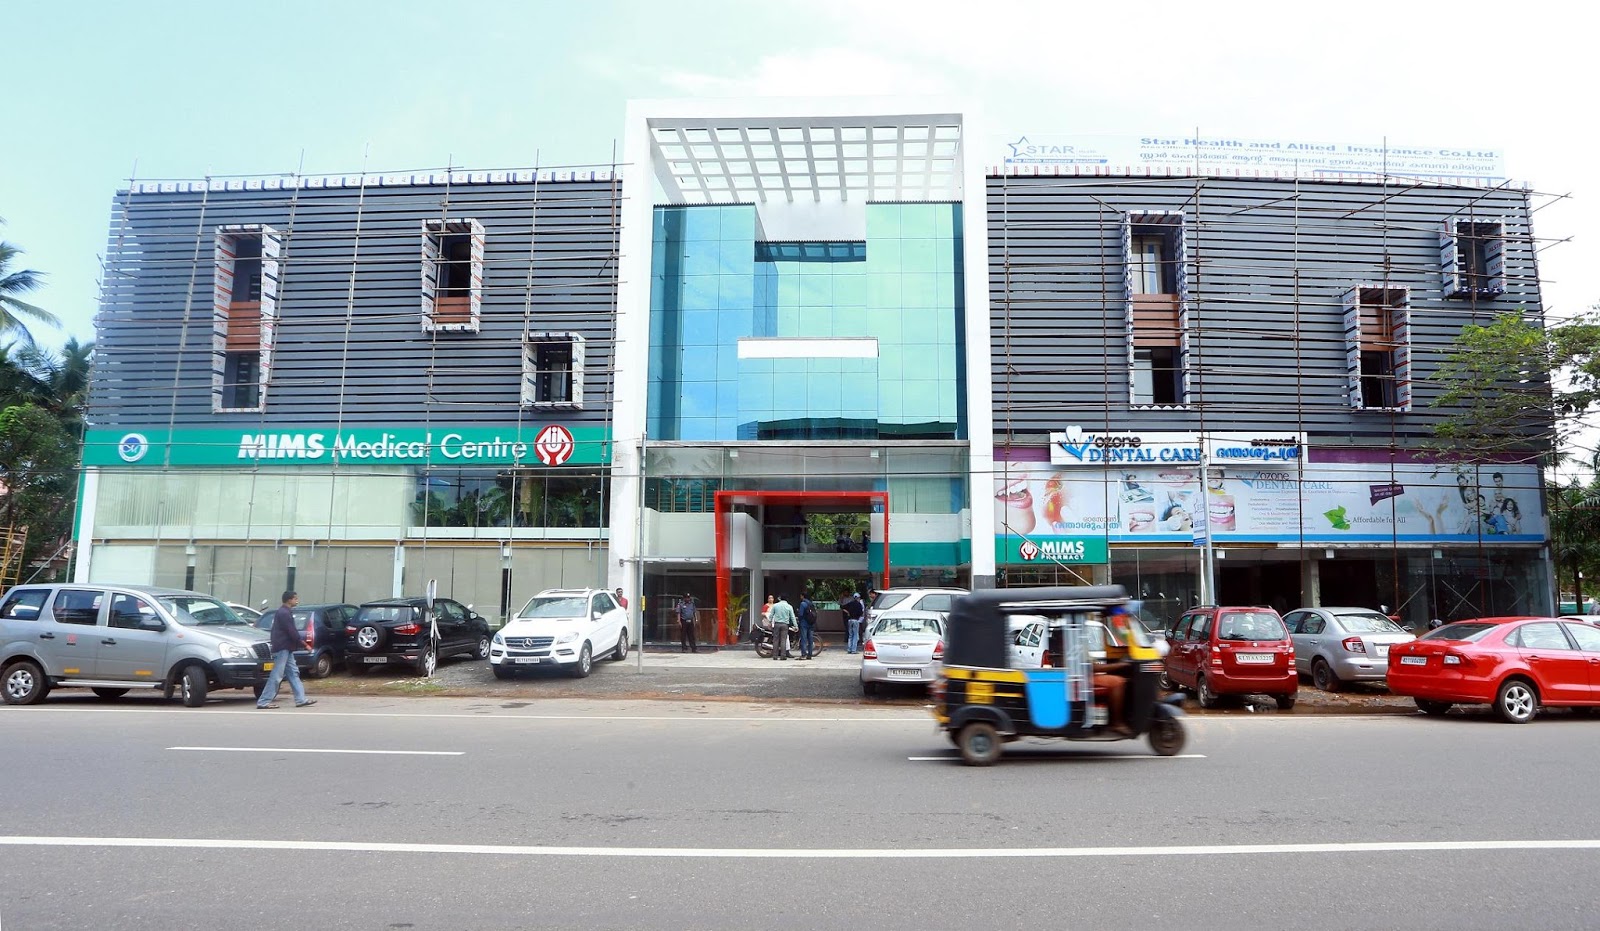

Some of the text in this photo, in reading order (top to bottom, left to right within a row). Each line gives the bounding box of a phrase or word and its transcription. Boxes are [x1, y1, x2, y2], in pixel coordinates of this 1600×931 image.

[1026, 145, 1074, 154] STAR
[1184, 138, 1243, 147] Health
[1286, 143, 1336, 151] Allied
[1347, 145, 1433, 155] Insurance
[237, 432, 527, 459] MIMS Medical Centre
[1089, 447, 1202, 462] DENTAL CARE
[1256, 480, 1333, 490] DENTAL CARE
[1041, 541, 1085, 554] MIMS
